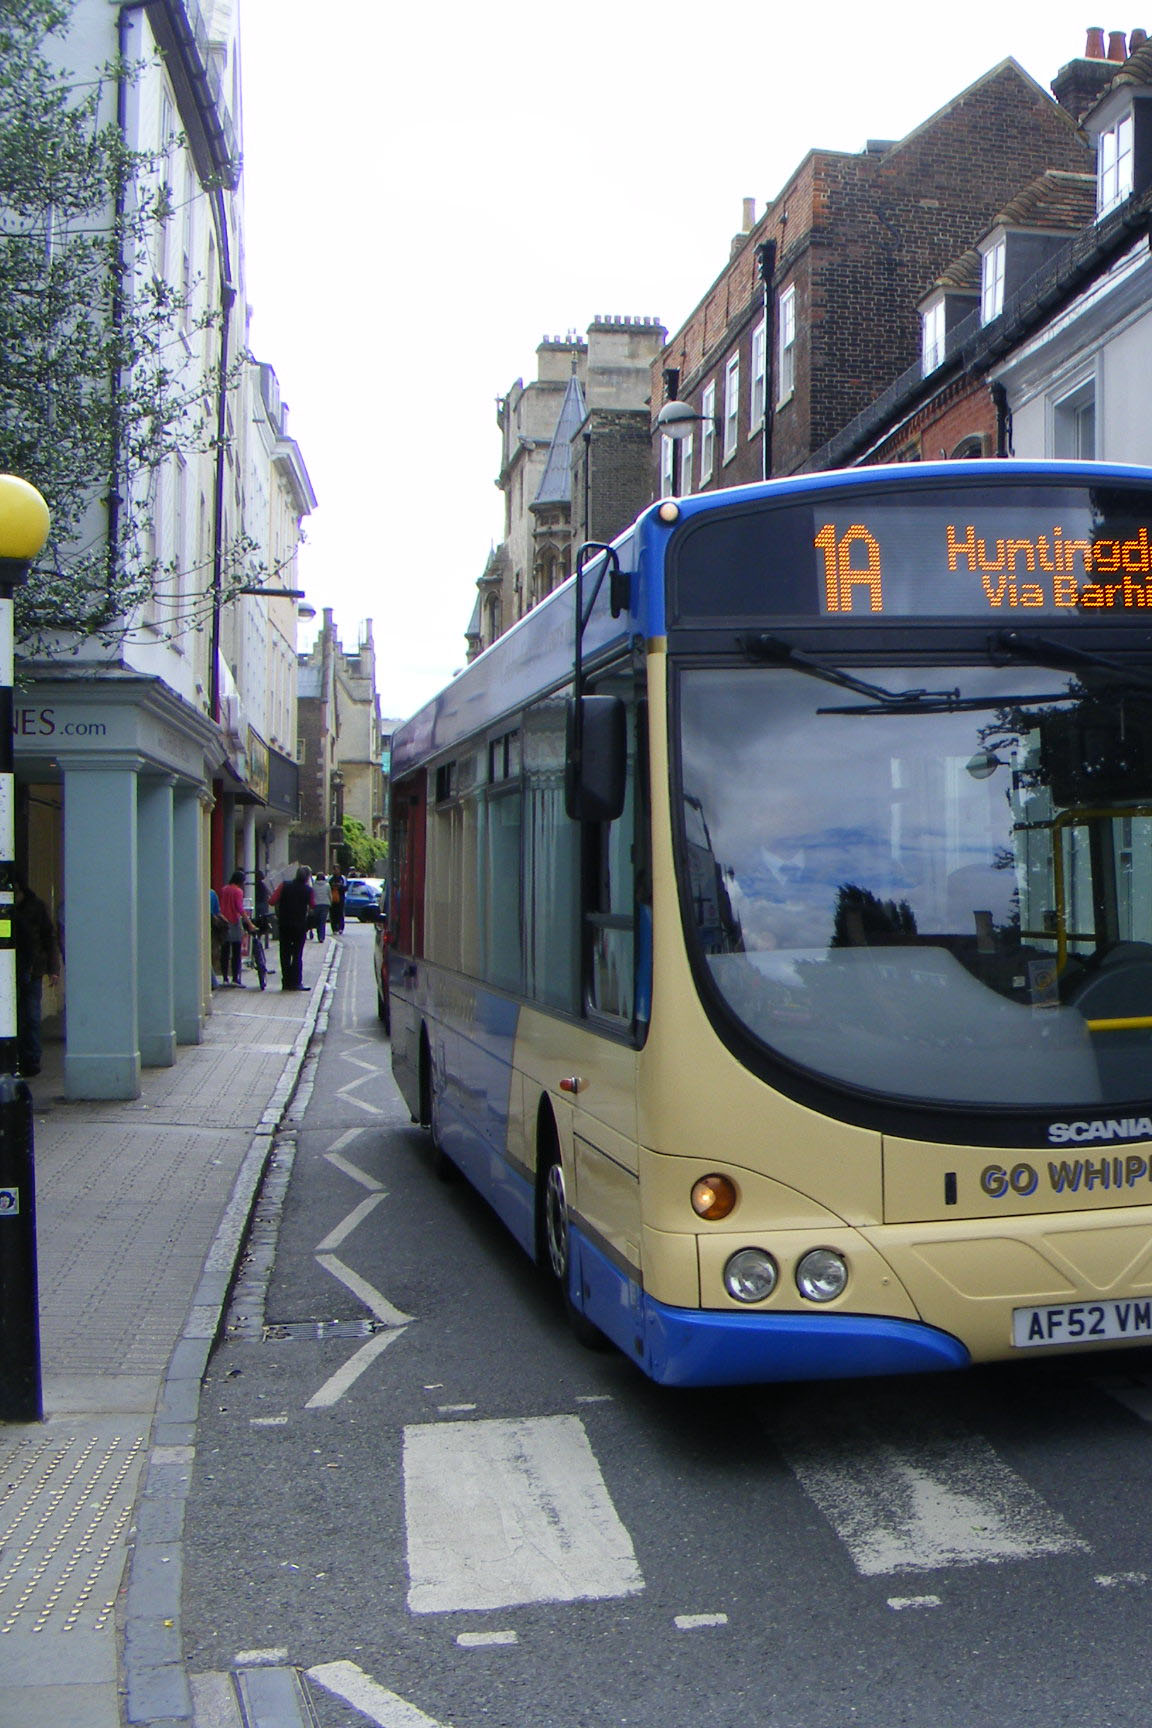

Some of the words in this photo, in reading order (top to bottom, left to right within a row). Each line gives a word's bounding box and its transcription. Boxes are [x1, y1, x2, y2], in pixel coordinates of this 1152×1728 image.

[813, 523, 884, 613] 1A
[981, 574, 1044, 608] Via
[980, 1162, 1038, 1199] GO
[1027, 1306, 1106, 1341] AF52
